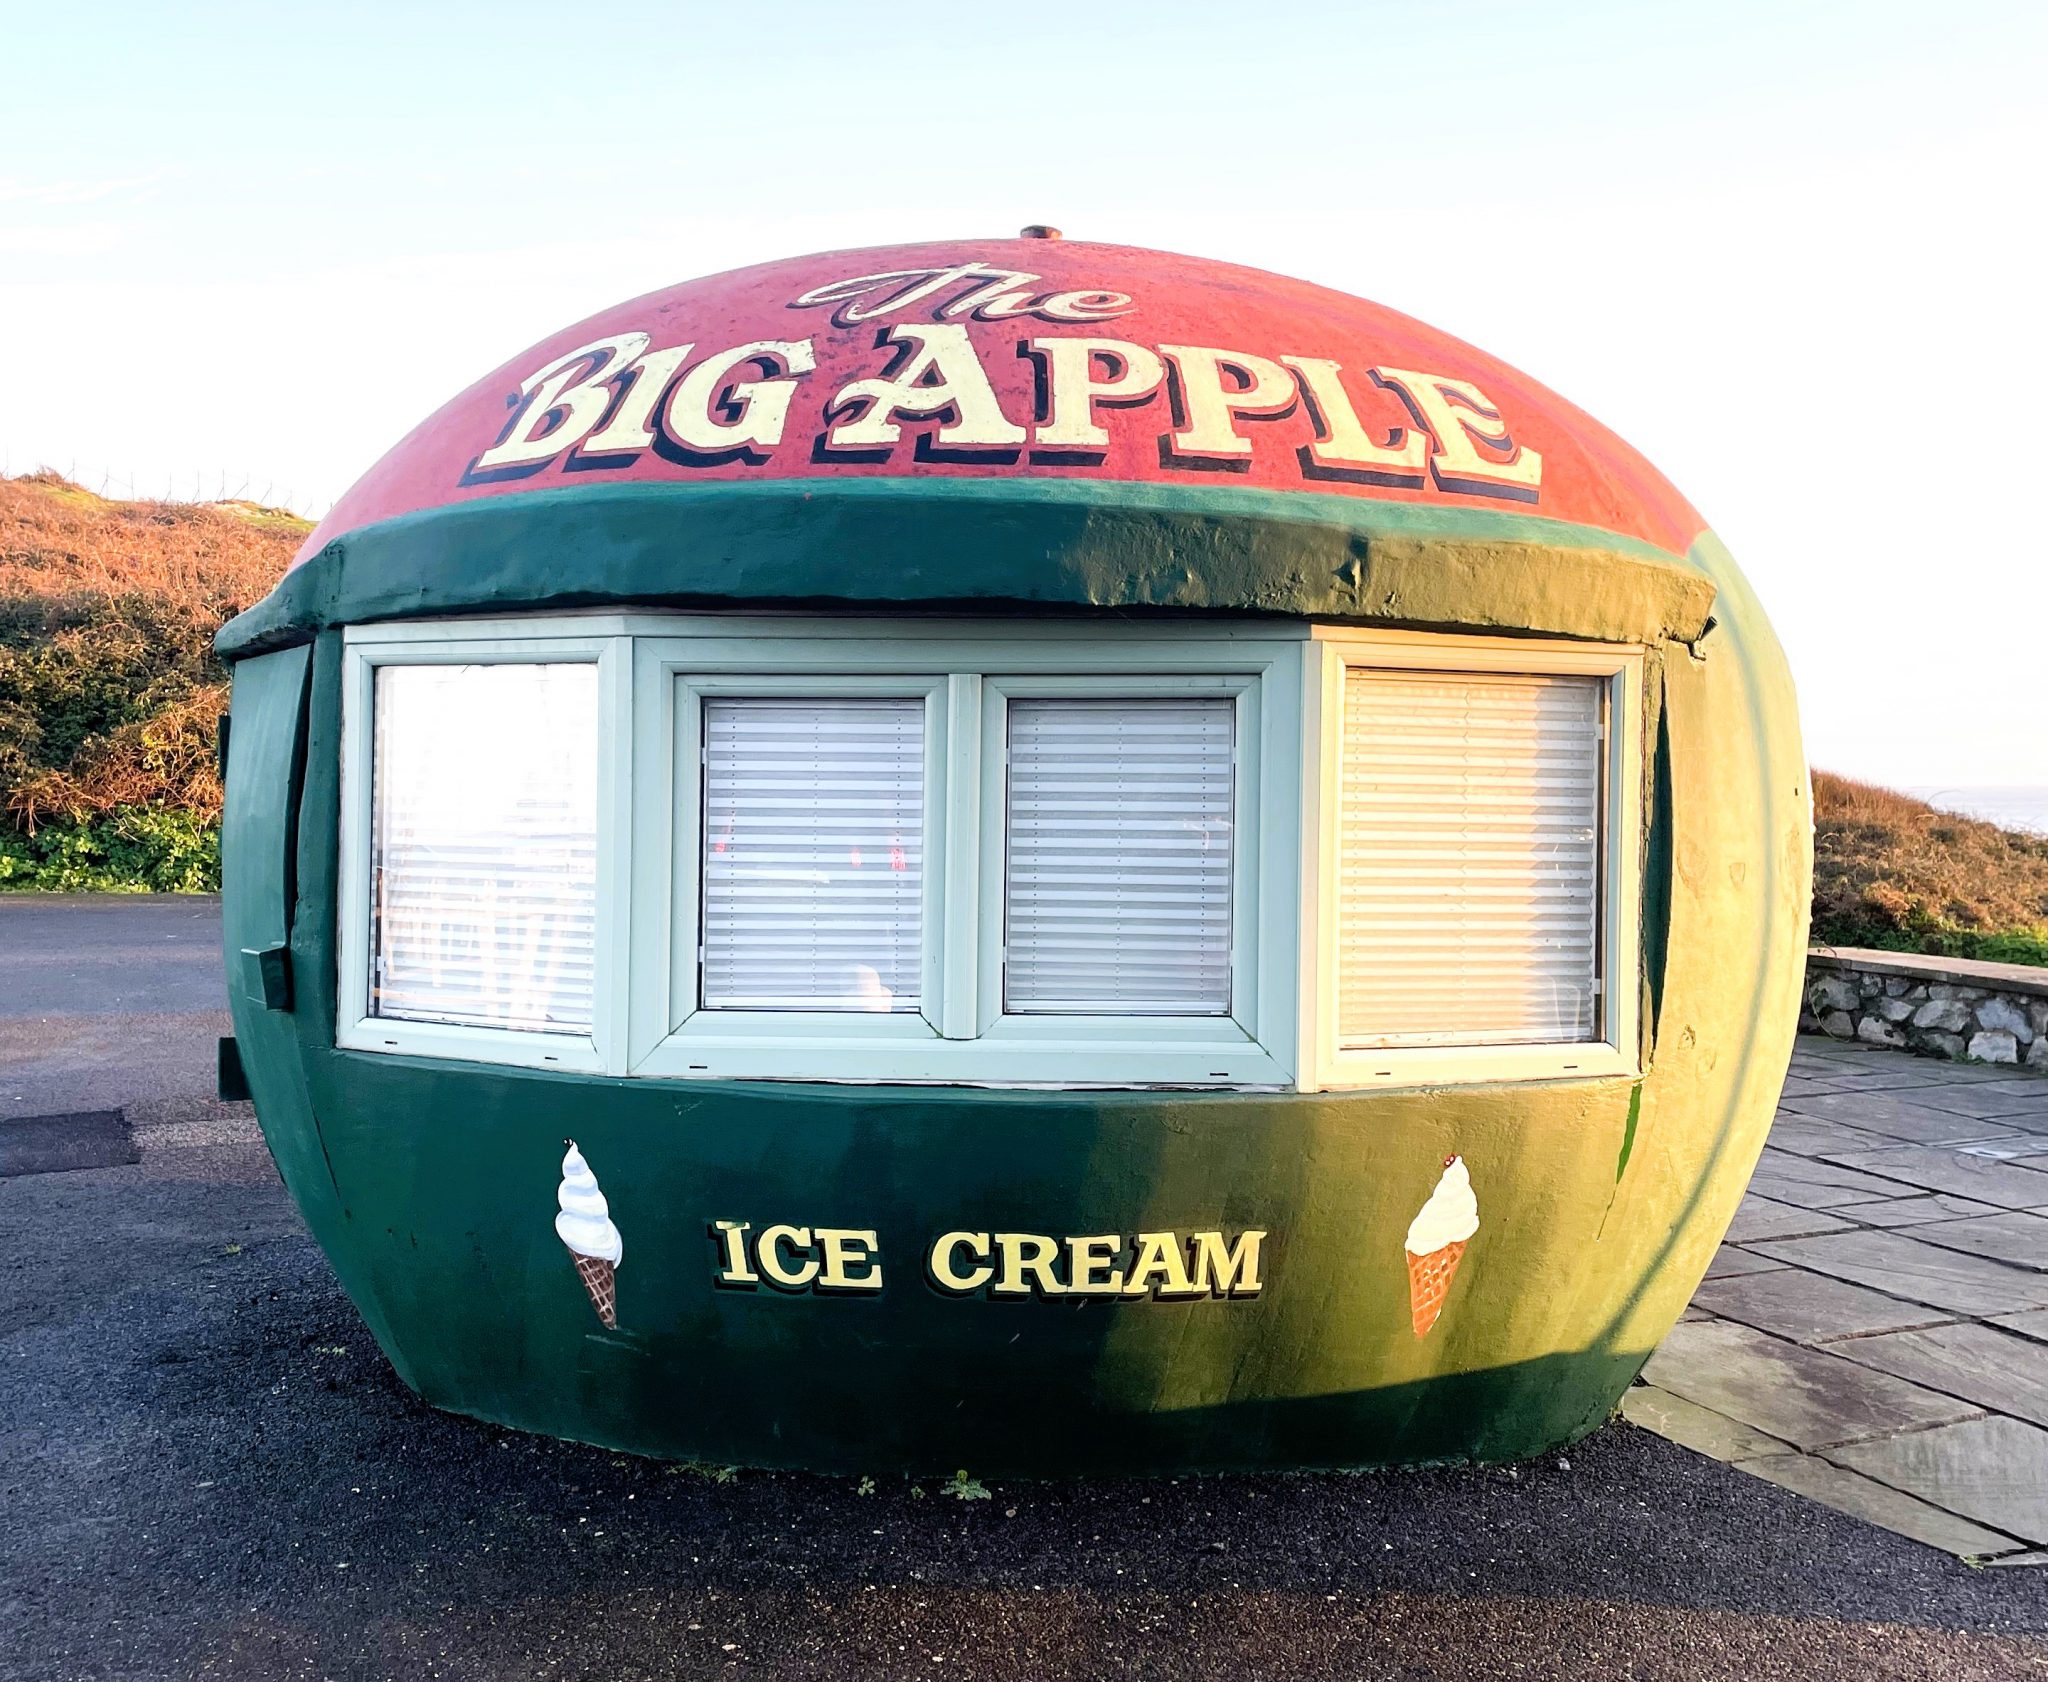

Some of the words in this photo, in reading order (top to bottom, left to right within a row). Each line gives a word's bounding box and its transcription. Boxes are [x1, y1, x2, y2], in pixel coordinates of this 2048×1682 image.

[795, 261, 1135, 323] The
[472, 331, 817, 470] BIG
[830, 323, 1543, 487] APPLE
[714, 1220, 883, 1289] ICE
[929, 1230, 1268, 1295] CREAM
